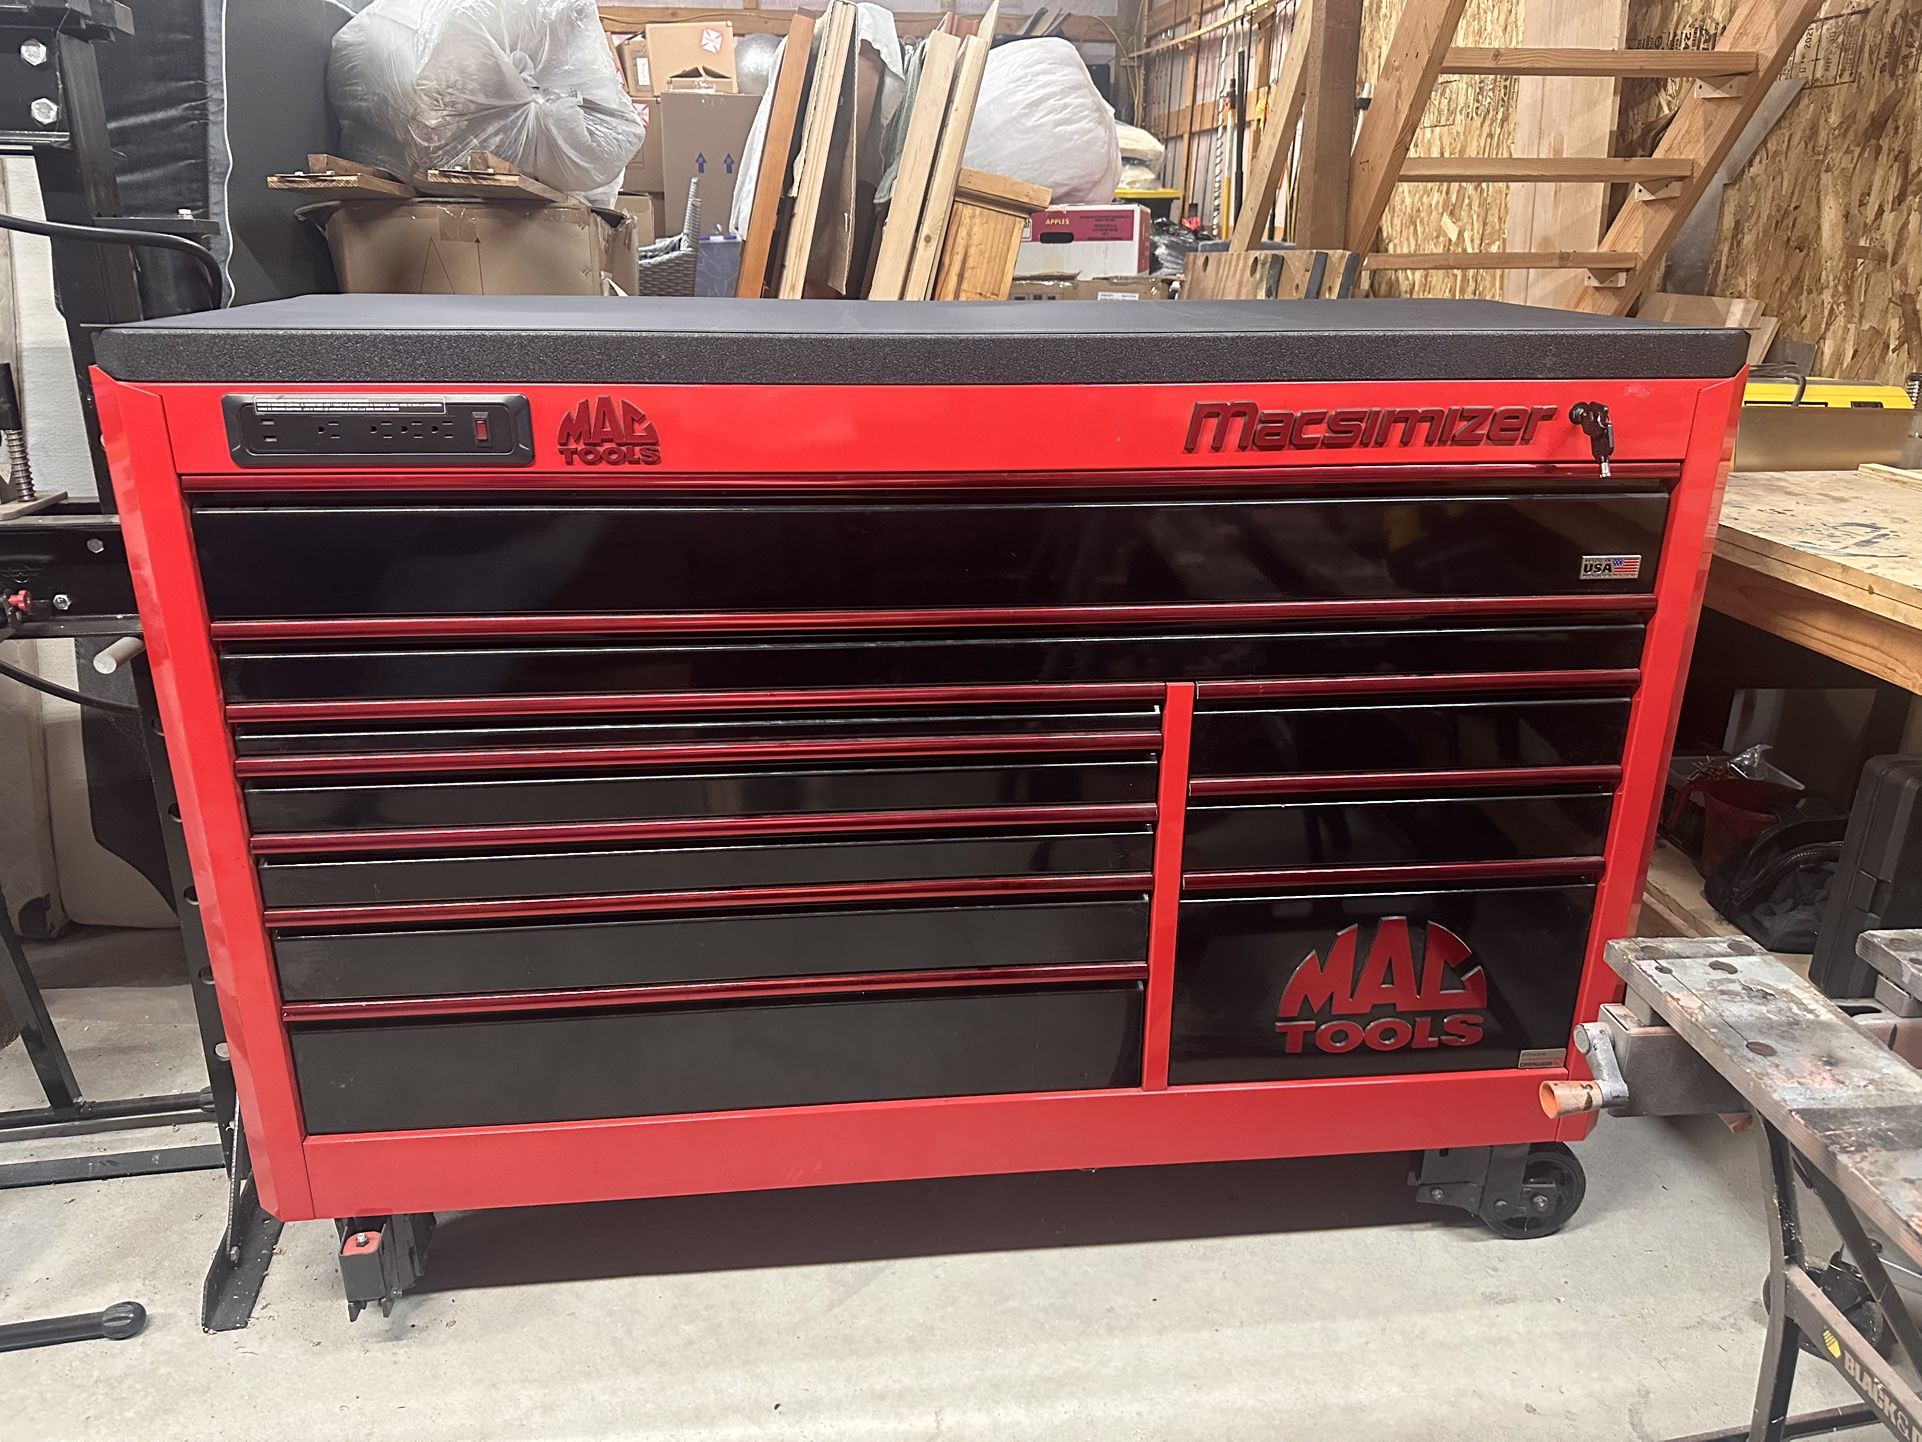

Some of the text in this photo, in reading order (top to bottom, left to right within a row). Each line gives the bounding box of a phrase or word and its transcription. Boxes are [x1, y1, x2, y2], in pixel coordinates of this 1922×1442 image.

[1804, 27, 1815, 49] 2021
[1045, 218, 1070, 226] APPLES
[557, 394, 660, 447] MAC
[557, 446, 662, 466] TOOLS
[1583, 563, 1612, 574] USA
[1277, 915, 1488, 1018] MAC
[1275, 1014, 1484, 1054] TOOLS
